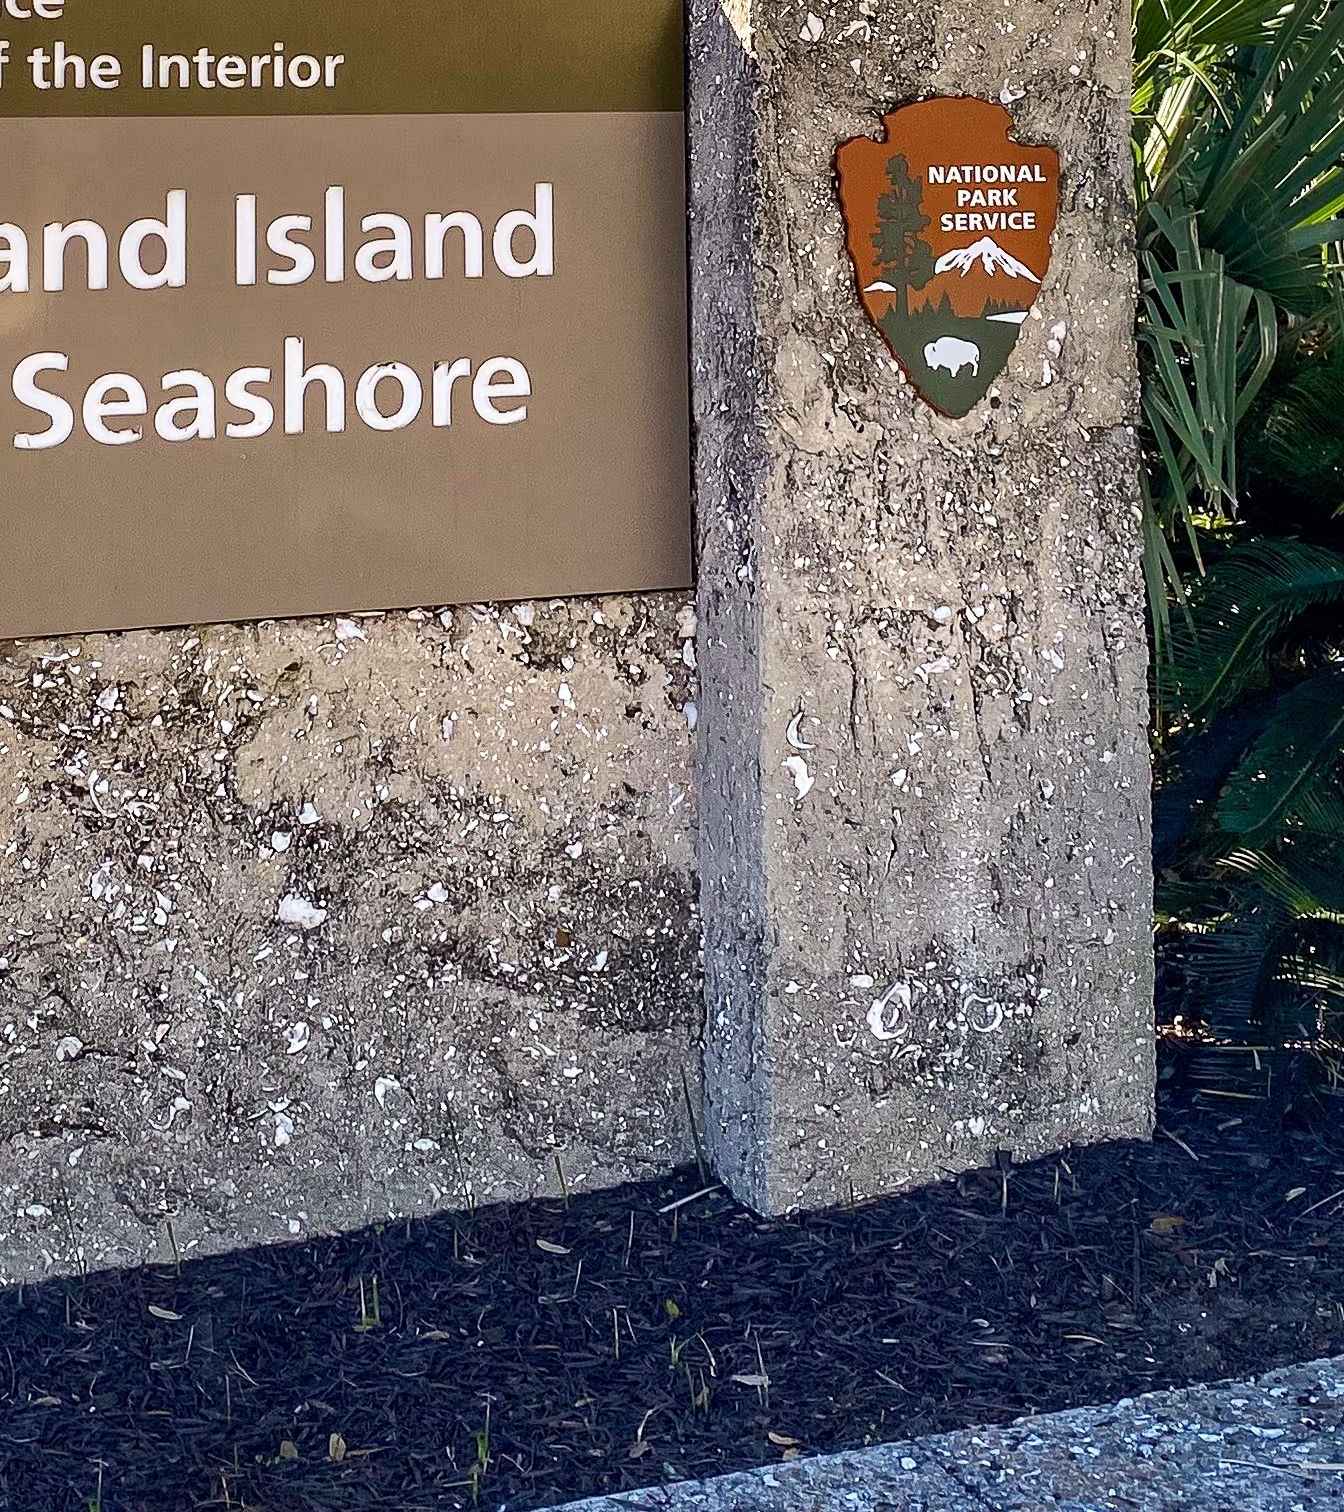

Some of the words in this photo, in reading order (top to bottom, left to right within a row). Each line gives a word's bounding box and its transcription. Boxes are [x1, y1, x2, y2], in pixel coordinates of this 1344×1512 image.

[25, 40, 122, 91] the
[141, 38, 346, 90] Interior
[927, 163, 1047, 185] NATIONAL
[956, 188, 1019, 208] PARK
[235, 181, 556, 287] Island
[939, 211, 1037, 233] SERVICE
[11, 335, 533, 450] Seashore
